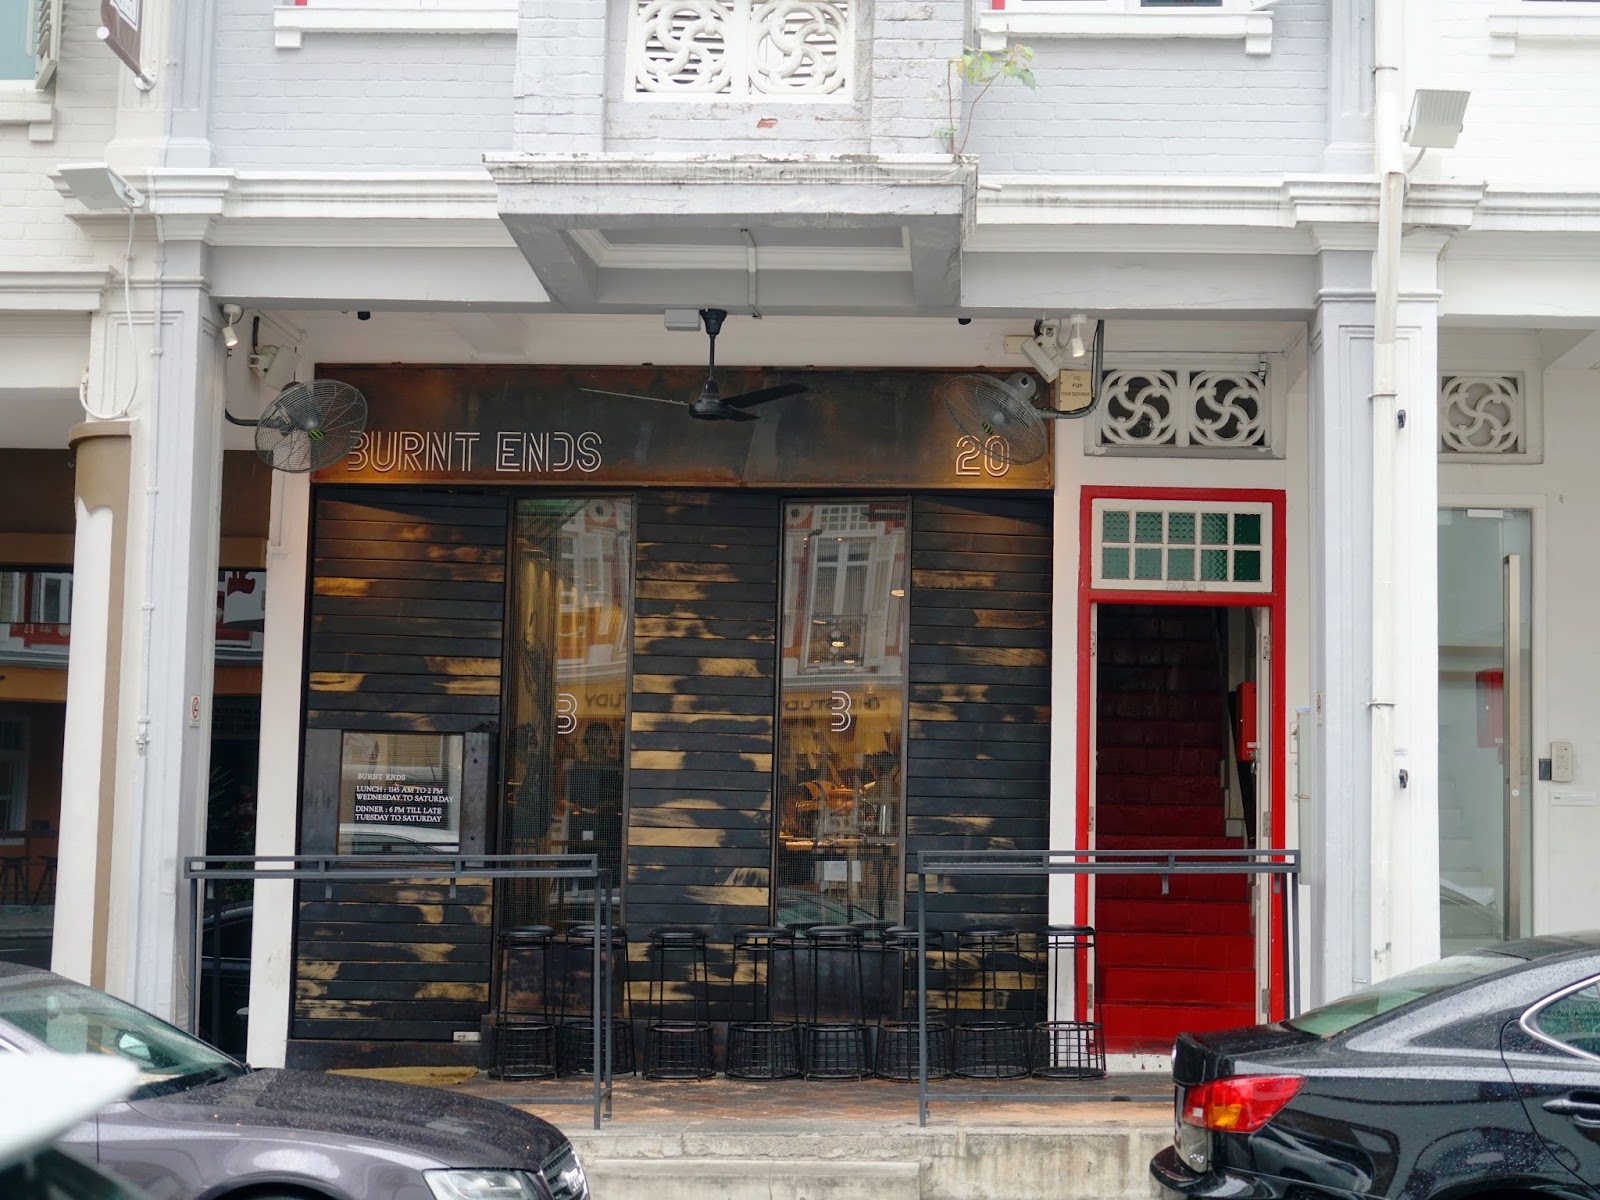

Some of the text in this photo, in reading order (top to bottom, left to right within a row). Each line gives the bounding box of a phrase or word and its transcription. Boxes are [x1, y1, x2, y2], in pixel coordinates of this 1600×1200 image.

[348, 431, 603, 472] BURNT ENDS
[956, 435, 1010, 477] 20
[356, 785, 382, 793] LUNCH
[356, 793, 454, 803] WEDNESDAY TO SATURDAY
[355, 805, 384, 813] DINNER
[423, 807, 442, 815] LATE
[355, 813, 389, 821] TUESDAY
[402, 815, 442, 823] SATURDAY
